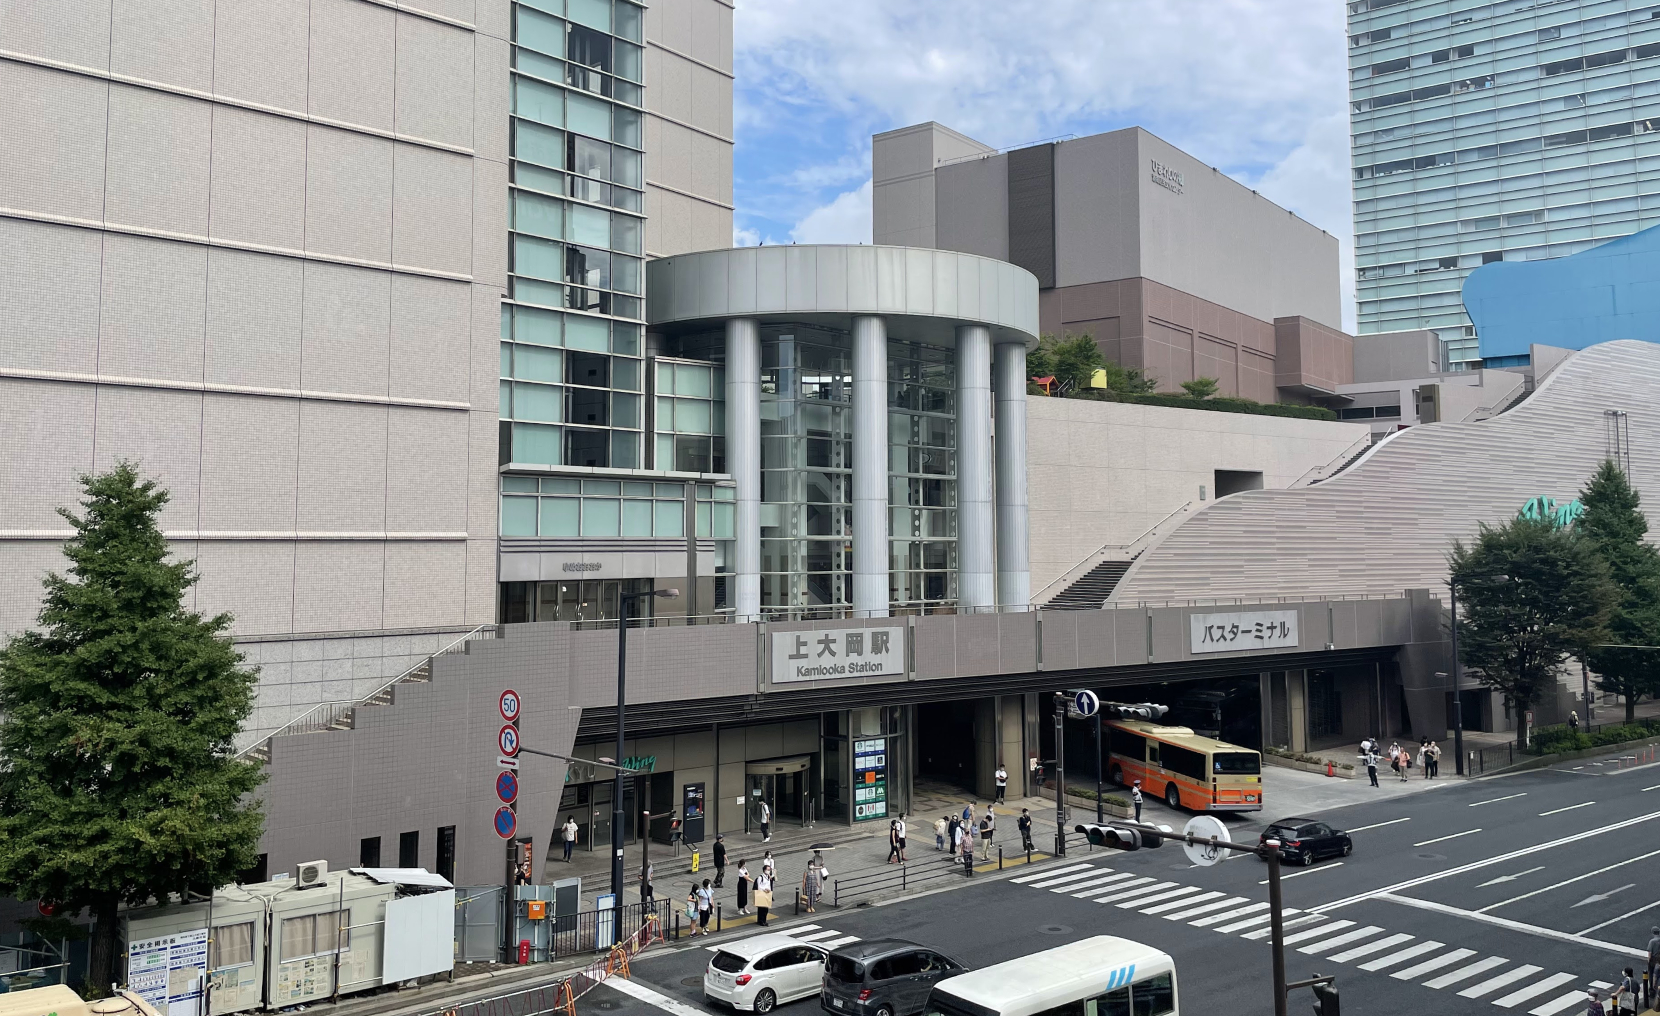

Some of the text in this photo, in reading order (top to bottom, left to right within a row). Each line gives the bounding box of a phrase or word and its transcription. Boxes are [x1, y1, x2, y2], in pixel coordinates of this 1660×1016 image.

[1201, 620, 1290, 644] バスターミナル
[788, 630, 890, 660] 上大岡駅
[796, 661, 883, 678] Kamiooka Station
[503, 698, 516, 713] 50
[622, 755, 657, 774] Wing
